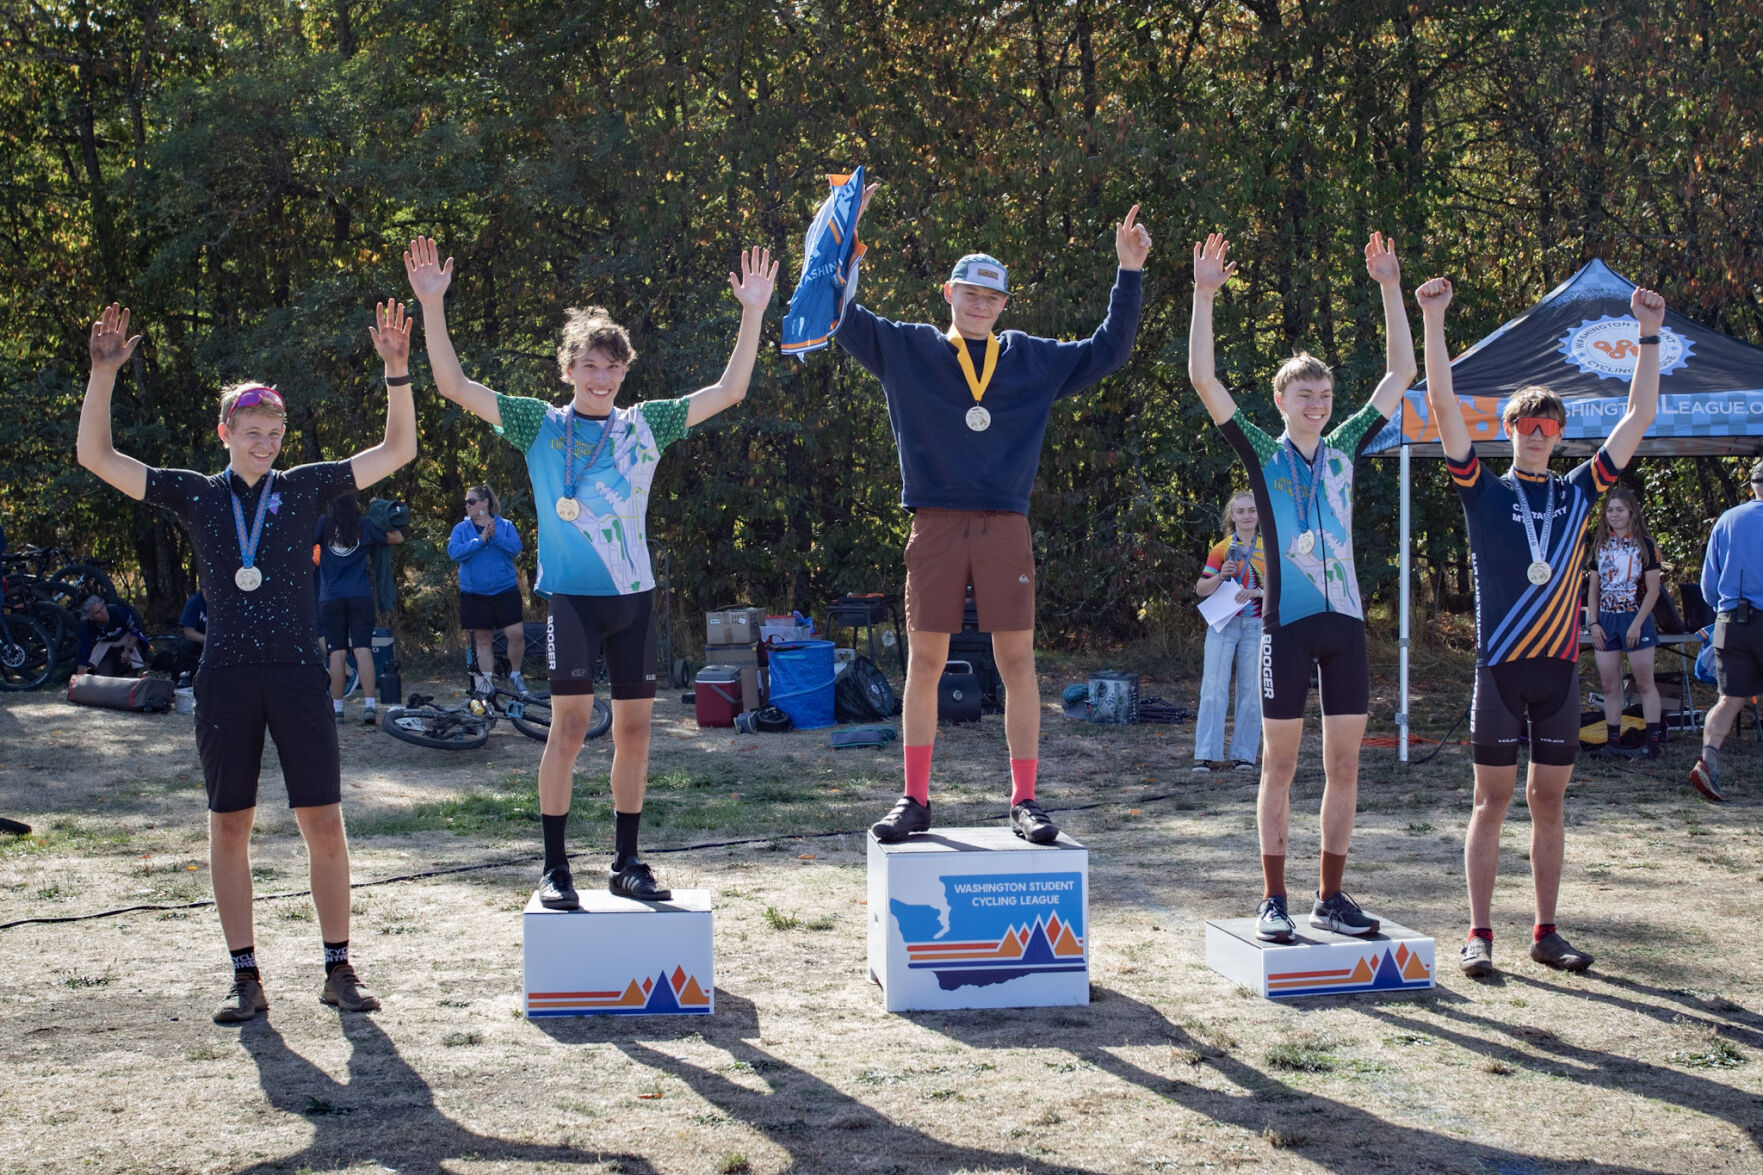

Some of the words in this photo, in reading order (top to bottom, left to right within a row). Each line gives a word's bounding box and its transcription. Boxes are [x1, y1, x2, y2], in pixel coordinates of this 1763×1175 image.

[547, 615, 557, 671] BOOGER
[1262, 633, 1275, 700] BOOGER
[953, 882, 1027, 894] WASHINGTON
[1029, 880, 1075, 892] STUDENT
[972, 896, 1018, 907] CYCLING
[1020, 894, 1060, 906] LEAGUE
